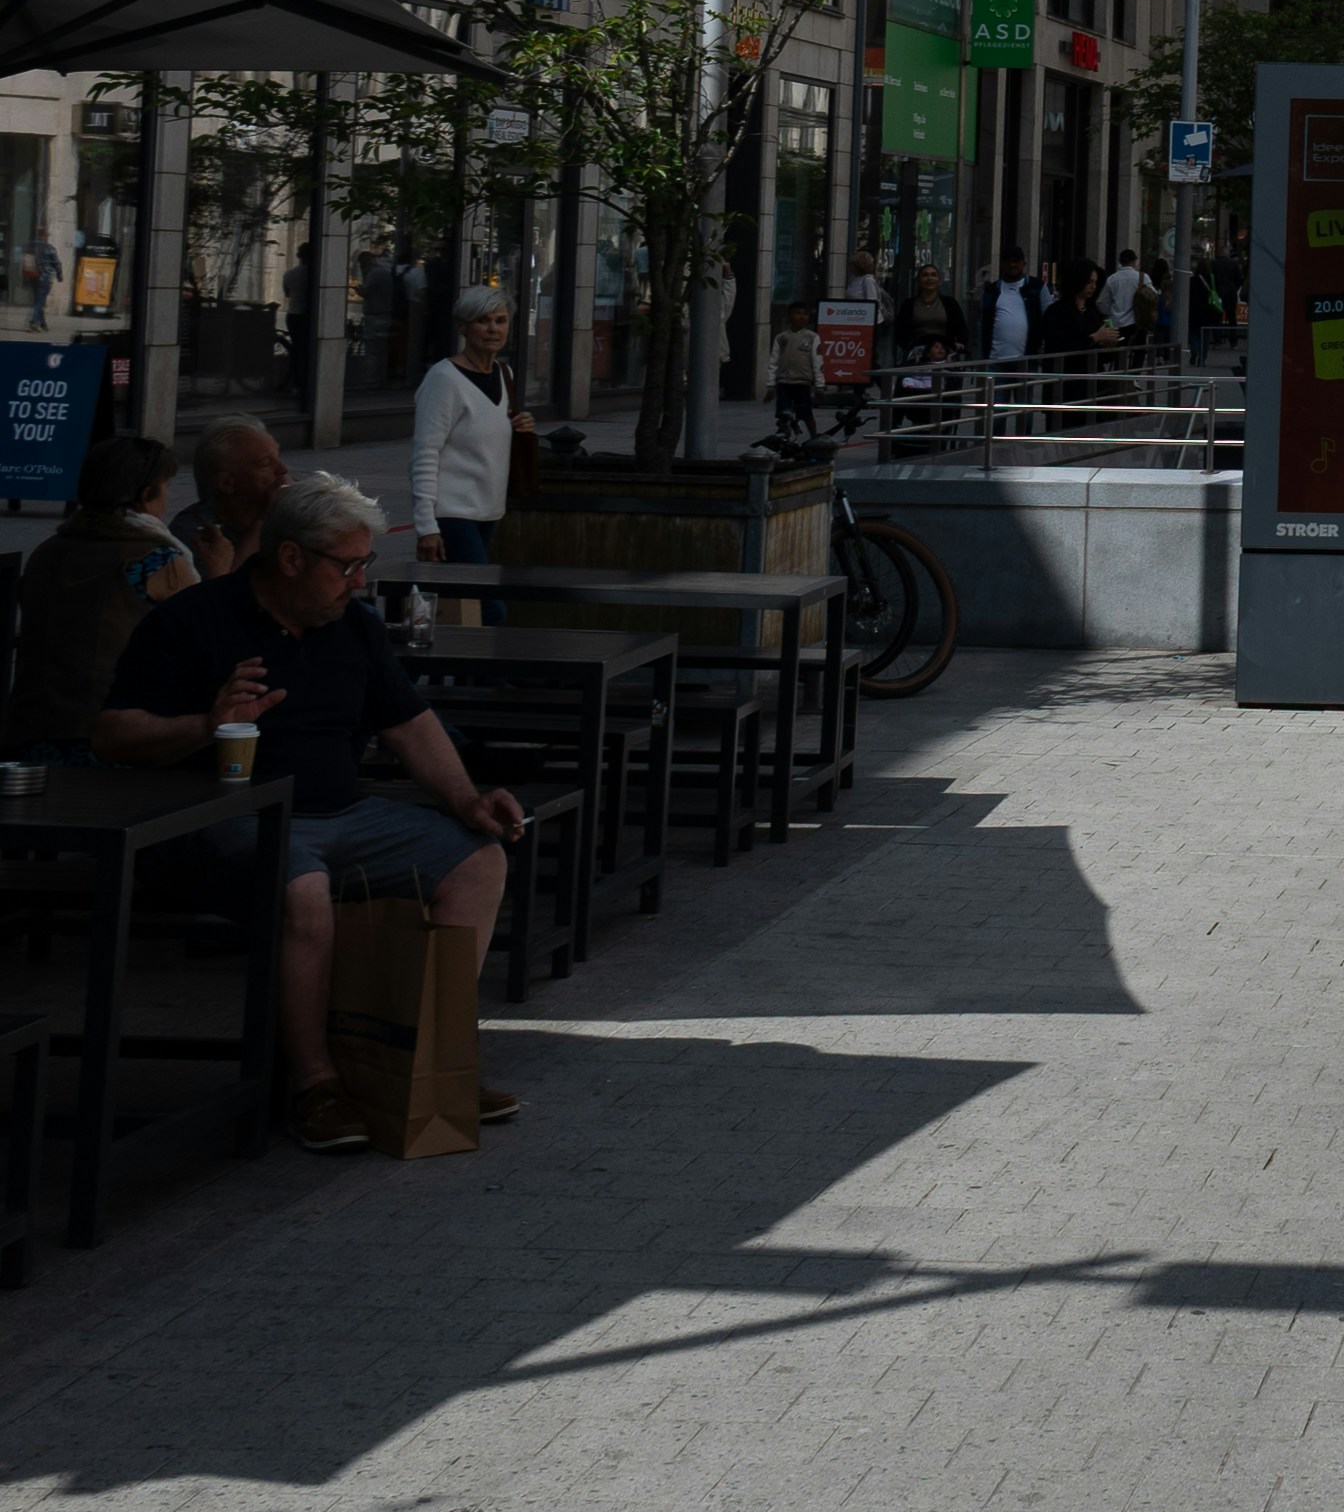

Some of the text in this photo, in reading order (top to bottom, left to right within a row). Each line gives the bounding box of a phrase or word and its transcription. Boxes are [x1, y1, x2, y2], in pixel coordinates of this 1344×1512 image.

[974, 23, 1031, 41] ASD
[824, 340, 866, 358] 70%
[17, 379, 69, 399] GOOD
[8, 400, 71, 421] TO SEE
[12, 422, 57, 442] YOU!
[1275, 522, 1339, 538] STRÖER
